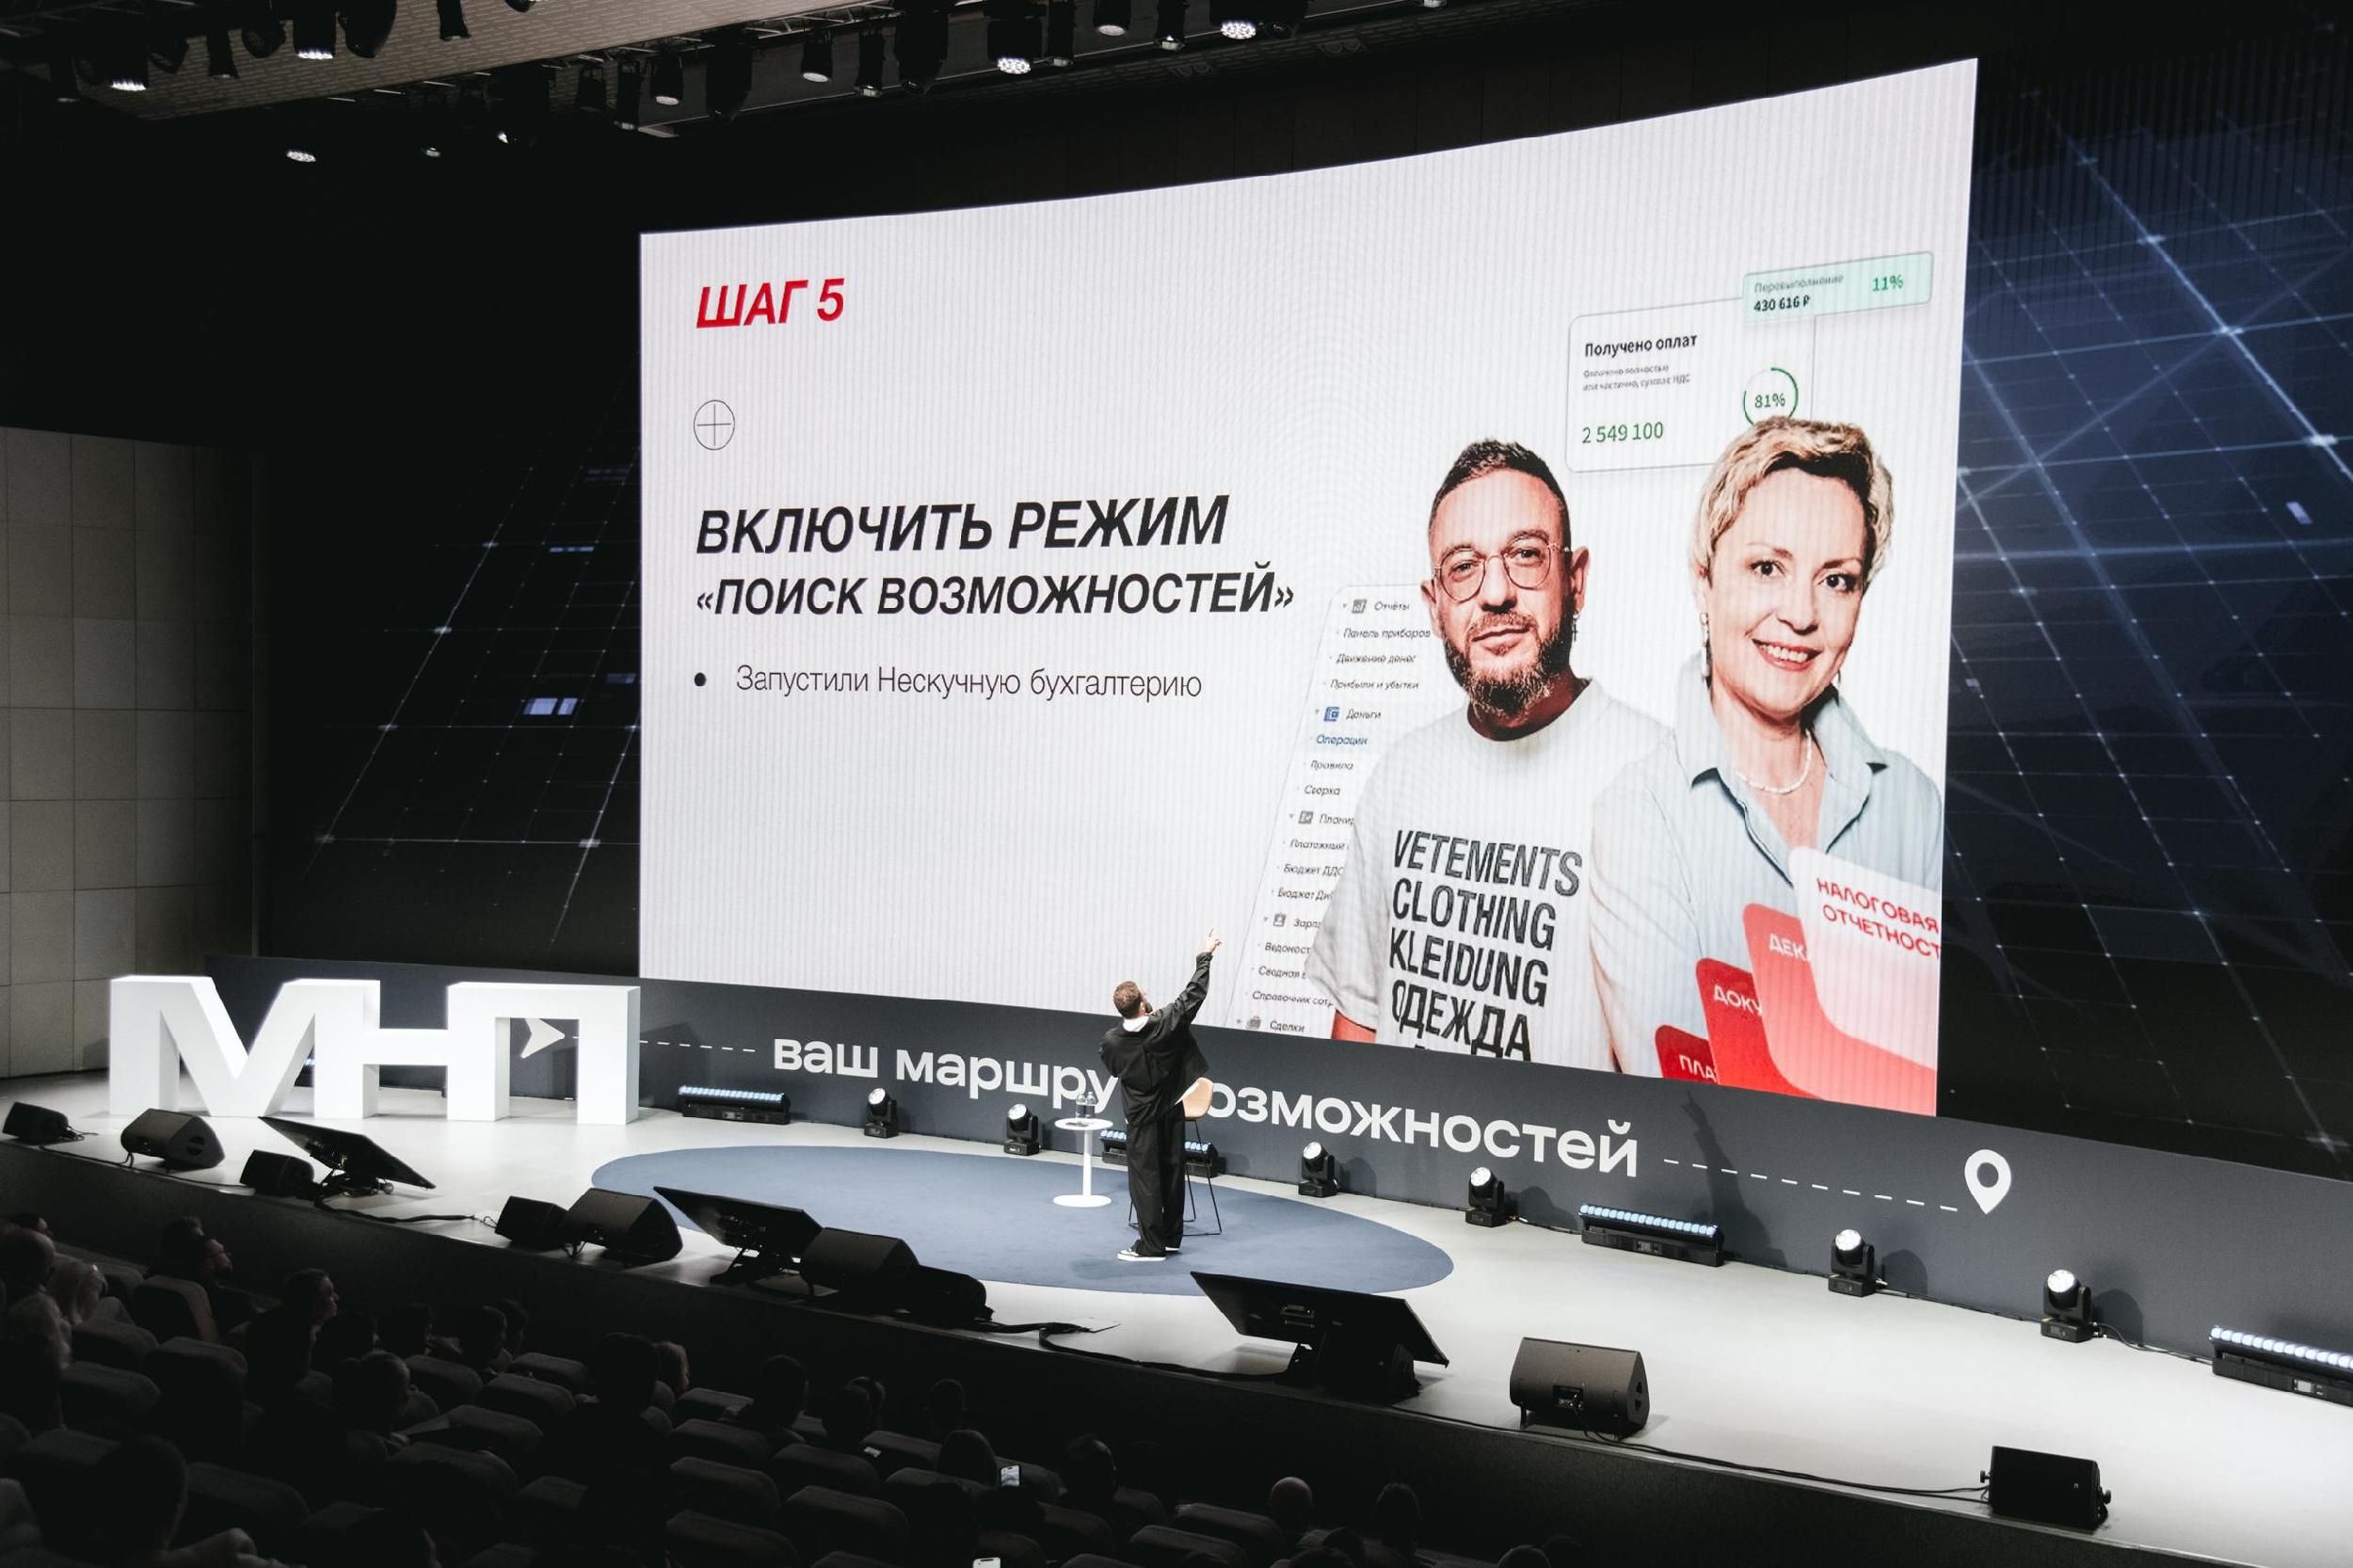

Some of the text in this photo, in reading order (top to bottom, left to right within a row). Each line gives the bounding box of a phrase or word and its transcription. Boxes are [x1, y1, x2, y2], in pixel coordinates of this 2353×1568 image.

[1872, 274, 1904, 292] 11%
[696, 278, 844, 328] ШАГ 5
[1753, 298, 1776, 312] 430
[1779, 296, 1801, 310] 616
[1584, 334, 1698, 359] Получено оплат
[1754, 392, 1785, 408] 81%
[1582, 422, 1664, 443] 2 549 100
[696, 494, 1230, 554] ВКЛЮЧИТЬ РЕЖИМ
[696, 560, 1294, 616] «ПОИСК ВОЗМОЖНОСТЕЙ»
[1343, 628, 1431, 640] Панель приборов
[1336, 653, 1386, 664] Движение
[736, 664, 1203, 703] Запустили Нескучную бухгалтерию
[1330, 679, 1374, 689] Прибыли
[1385, 680, 1419, 691] убытки
[1345, 708, 1382, 720] Деньги
[1316, 734, 1369, 746] Операции
[1310, 760, 1354, 771] Правила
[1304, 784, 1341, 796] Сверка
[1283, 863, 1321, 875] Бюджет
[1394, 829, 1583, 897] VETEMENTS
[1393, 877, 1557, 952] CLOTHING
[1816, 876, 1939, 935] НАЛОГОВАЯ
[1822, 904, 1940, 960] ОТЧЕТНОСТ
[1258, 965, 1300, 978] Сводная
[1389, 926, 1549, 1007] KLEIDUNG
[1270, 1019, 1305, 1032] Сделки
[1391, 979, 1532, 1063] ОДЕЖДА
[109, 975, 640, 1126] МНП
[774, 1037, 1638, 1178] ваш маршру озможностей
